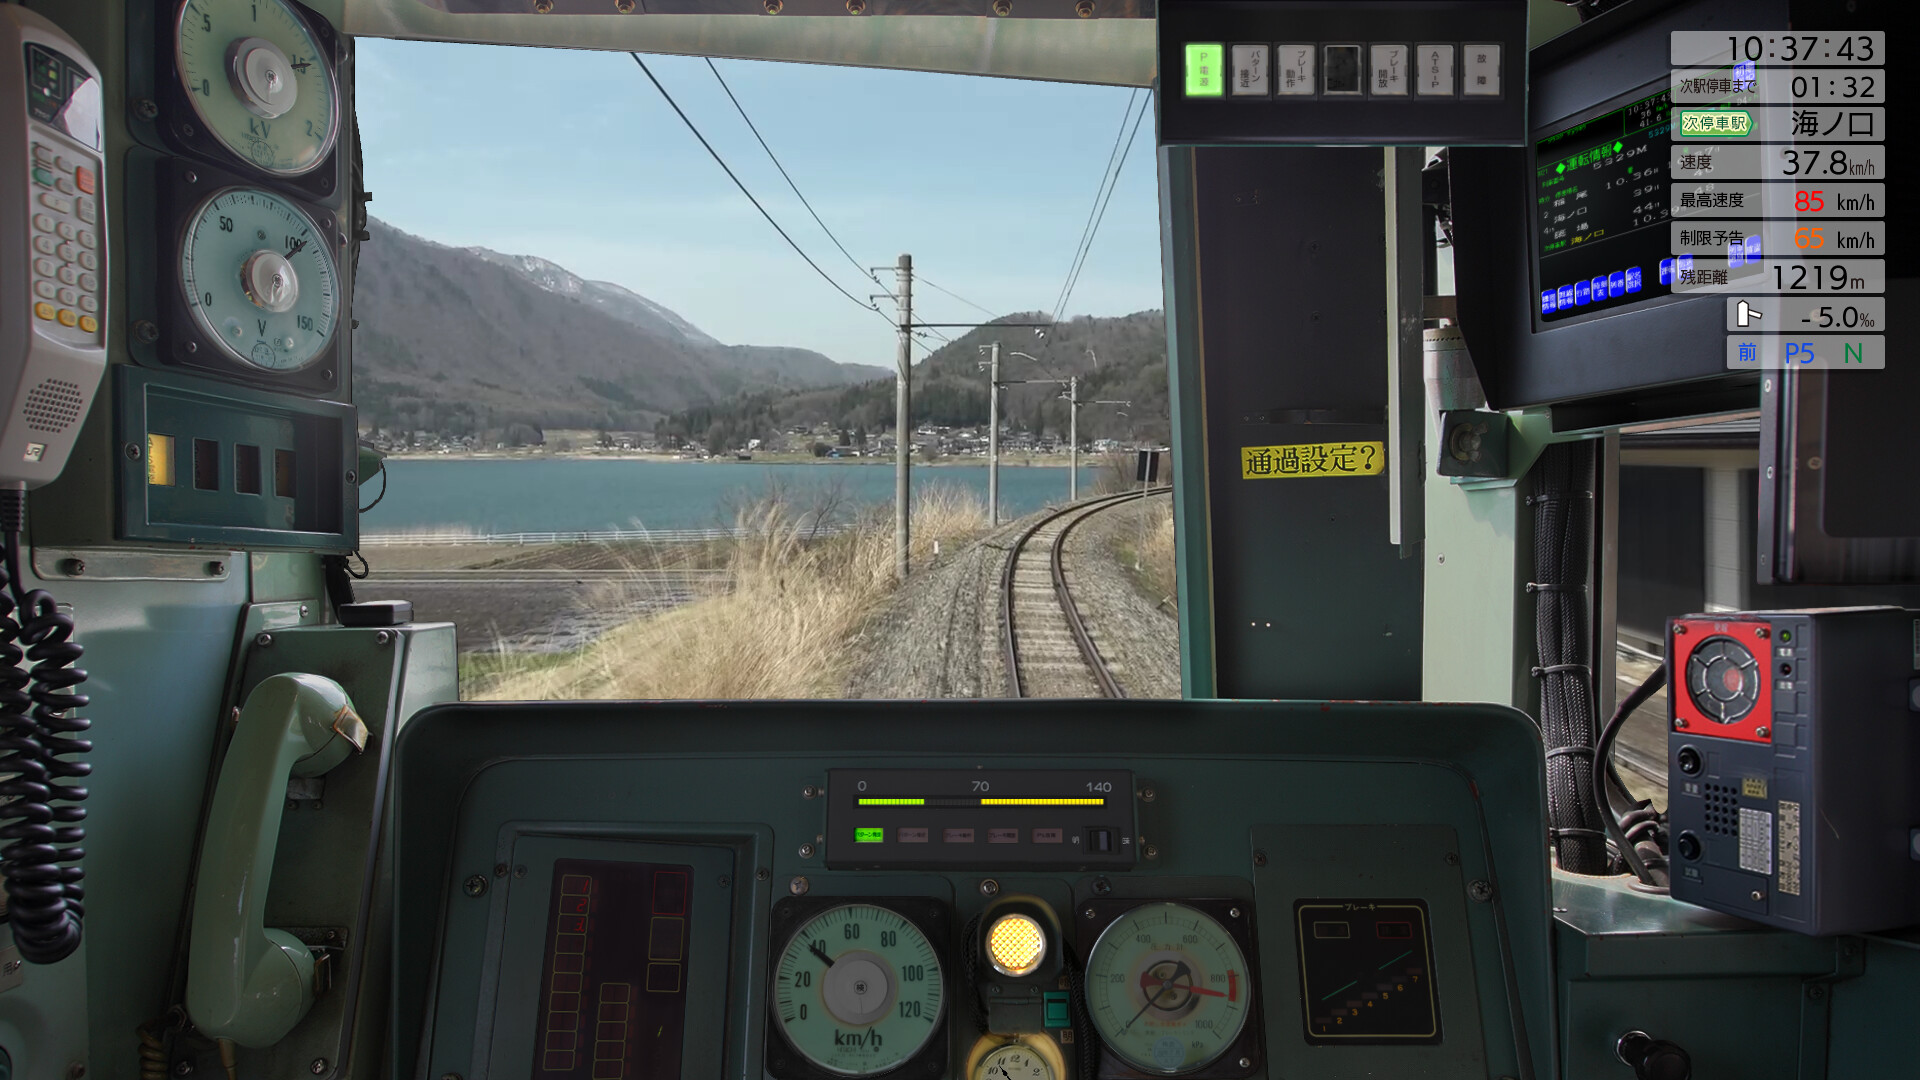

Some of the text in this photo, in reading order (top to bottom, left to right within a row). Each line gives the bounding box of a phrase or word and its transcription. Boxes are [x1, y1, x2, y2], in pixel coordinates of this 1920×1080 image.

[251, 5, 257, 22] 1
[1297, 50, 1306, 83] ブレーキ
[1389, 50, 1399, 83] ブレーキ
[1286, 69, 1296, 88] 動作
[1378, 69, 1388, 88] 開放
[202, 79, 210, 96] 0
[250, 118, 271, 139] kV
[305, 120, 313, 136] 2
[219, 216, 233, 232] 50
[285, 235, 302, 251] 100
[205, 292, 212, 306] 0
[257, 319, 267, 337] V
[297, 315, 313, 331] 150
[1246, 444, 1376, 475] 通過設定?
[857, 781, 1112, 793] 0 70 140
[1345, 903, 1376, 911] ブレーキ
[844, 923, 860, 939] 60
[880, 931, 896, 947] 80
[1135, 934, 1150, 944] 400
[1182, 934, 1198, 944] 600
[795, 971, 811, 987] 20
[902, 965, 923, 981] 100
[1110, 974, 1125, 983] 200
[1210, 974, 1226, 983] 800
[800, 1004, 807, 1020] 0
[899, 1001, 921, 1018] 120
[1195, 1020, 1213, 1029] 1000
[834, 1026, 882, 1049] km/h
